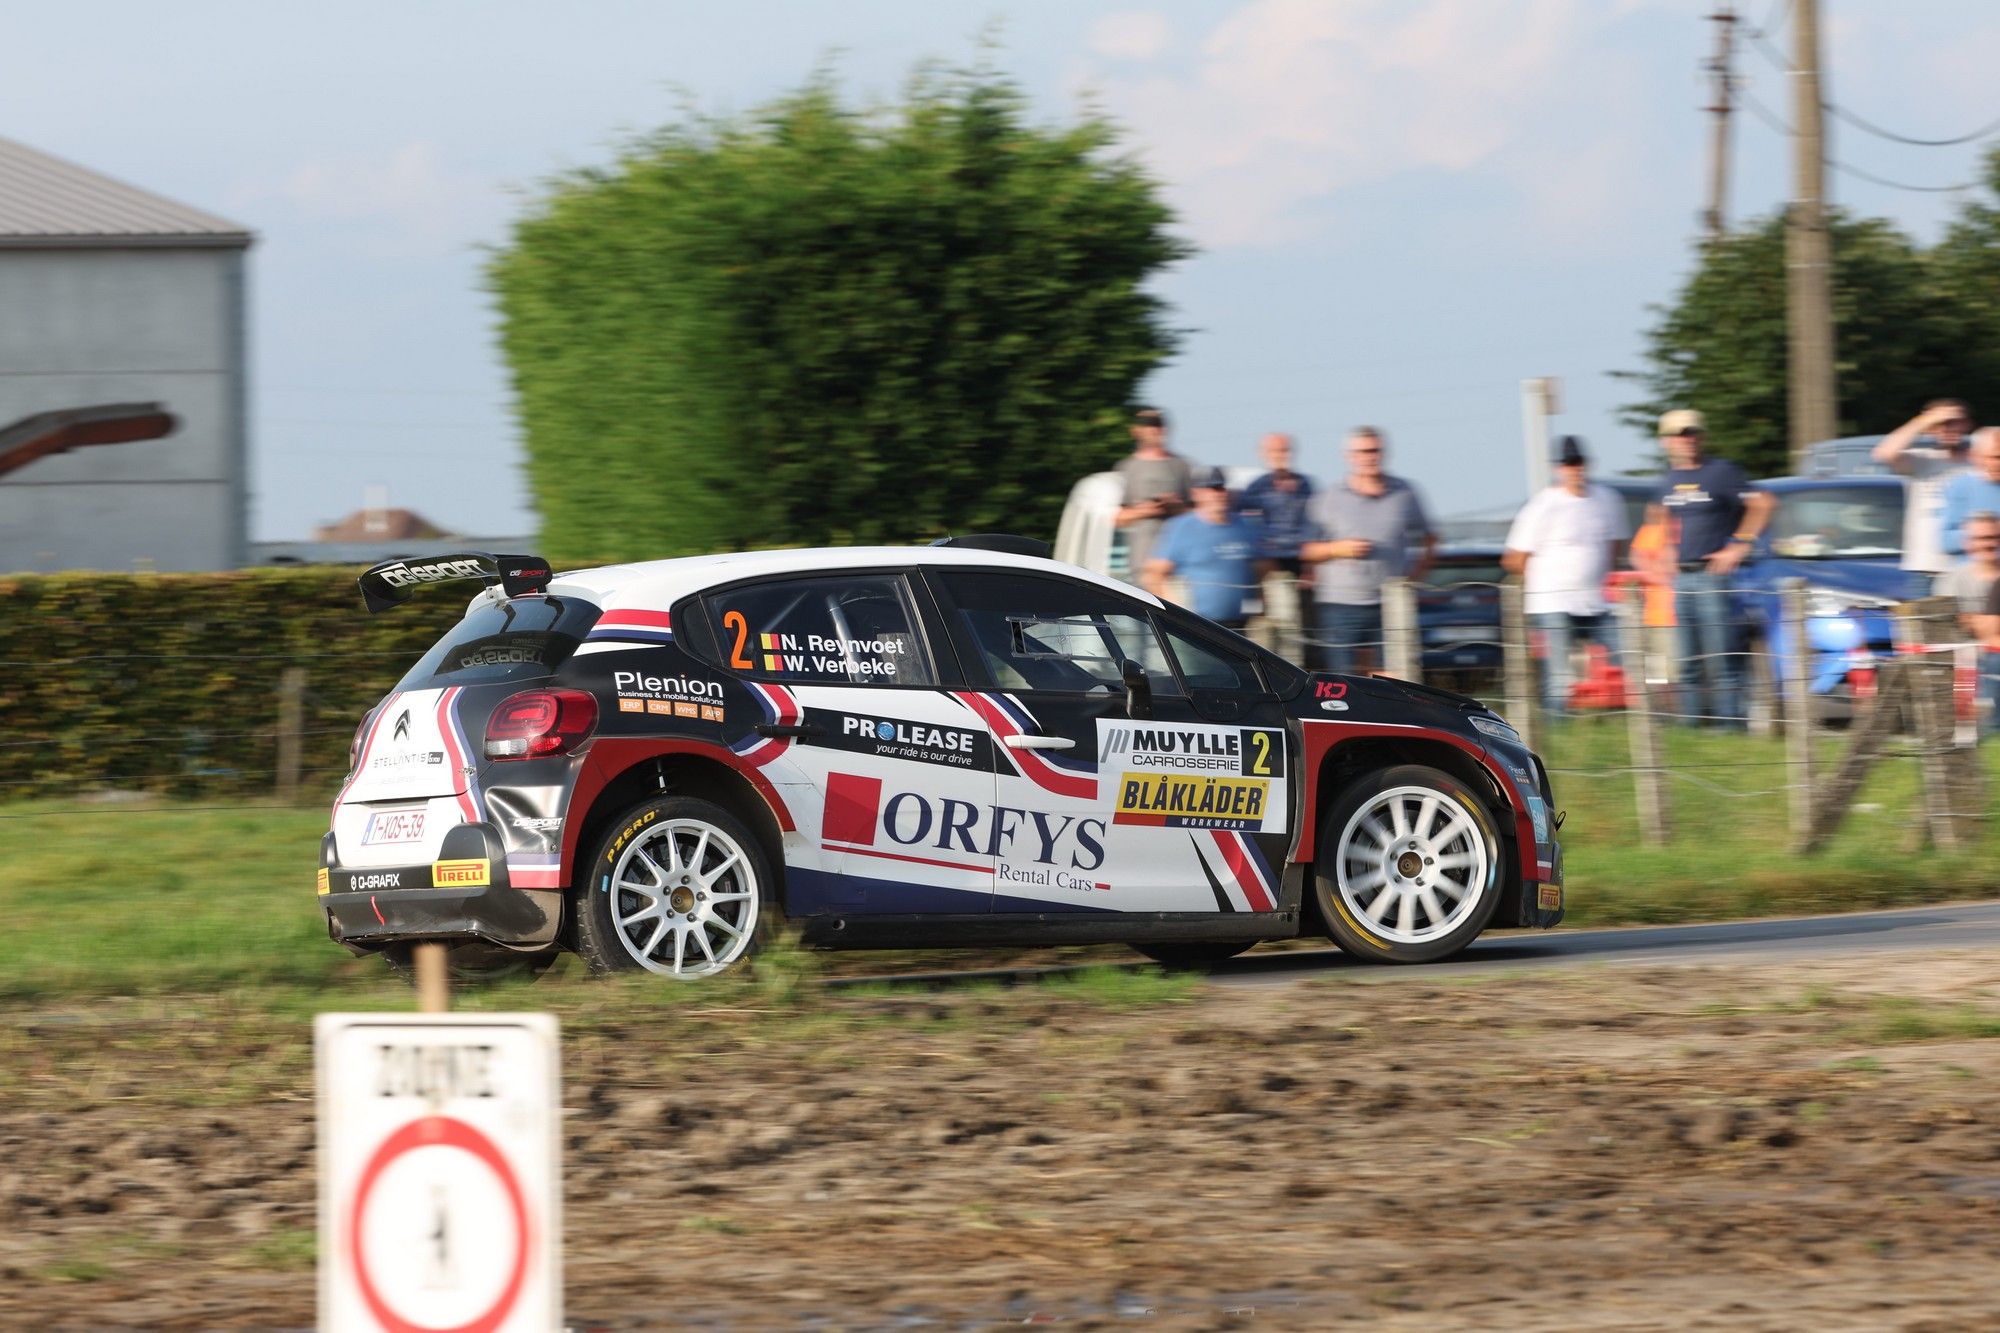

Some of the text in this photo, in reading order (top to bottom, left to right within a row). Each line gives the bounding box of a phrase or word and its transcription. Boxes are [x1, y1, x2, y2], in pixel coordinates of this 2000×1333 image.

[723, 610, 754, 670] 2
[781, 634, 905, 657] N. Reynvoet
[783, 655, 896, 675] W. Verbeke
[614, 672, 724, 698] Plenion
[623, 701, 640, 709] ERP
[649, 703, 669, 711] CRM
[663, 693, 689, 701] mobile
[690, 695, 724, 706] solutions
[677, 706, 696, 714] WMS
[1132, 729, 1239, 756] MUYLLE
[875, 744, 972, 765] your ride is our drive
[1132, 754, 1239, 771] CARROSSERIE
[1252, 732, 1271, 775] 2
[1122, 775, 1263, 816] BLÅKLÄDER
[883, 792, 1107, 871] ORFYS
[1181, 817, 1245, 829] WORKWEAR
[437, 864, 484, 882] PIRELLI
[999, 863, 1092, 892] Rental Cars
